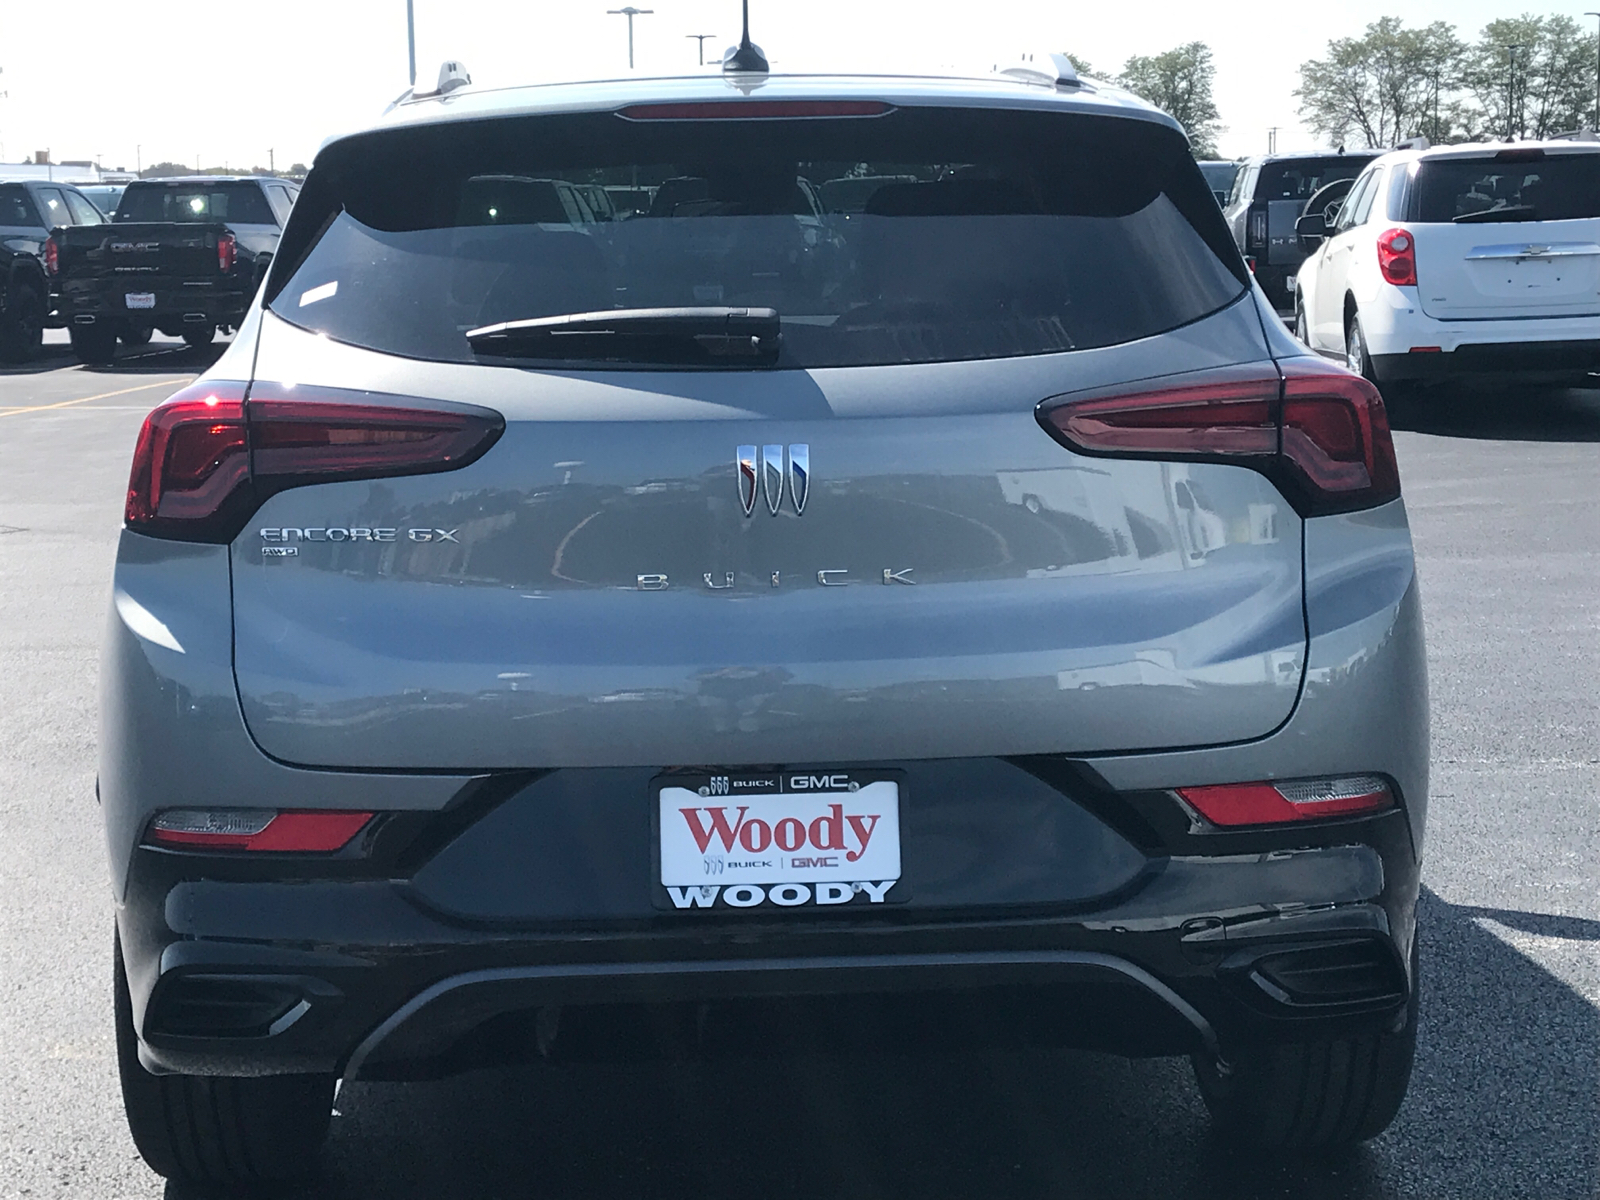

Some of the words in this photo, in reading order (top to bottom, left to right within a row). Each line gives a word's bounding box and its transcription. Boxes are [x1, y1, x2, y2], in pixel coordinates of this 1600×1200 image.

[260, 527, 397, 542] ENCORE
[408, 528, 460, 543] GX
[262, 547, 298, 556] AWD
[637, 568, 917, 590] BUICK
[733, 779, 774, 788] BUICK
[790, 775, 848, 789] GMC
[679, 804, 881, 862] Woody
[727, 860, 773, 868] BUICK
[791, 857, 839, 868] GMC
[666, 881, 897, 908] WOODY
